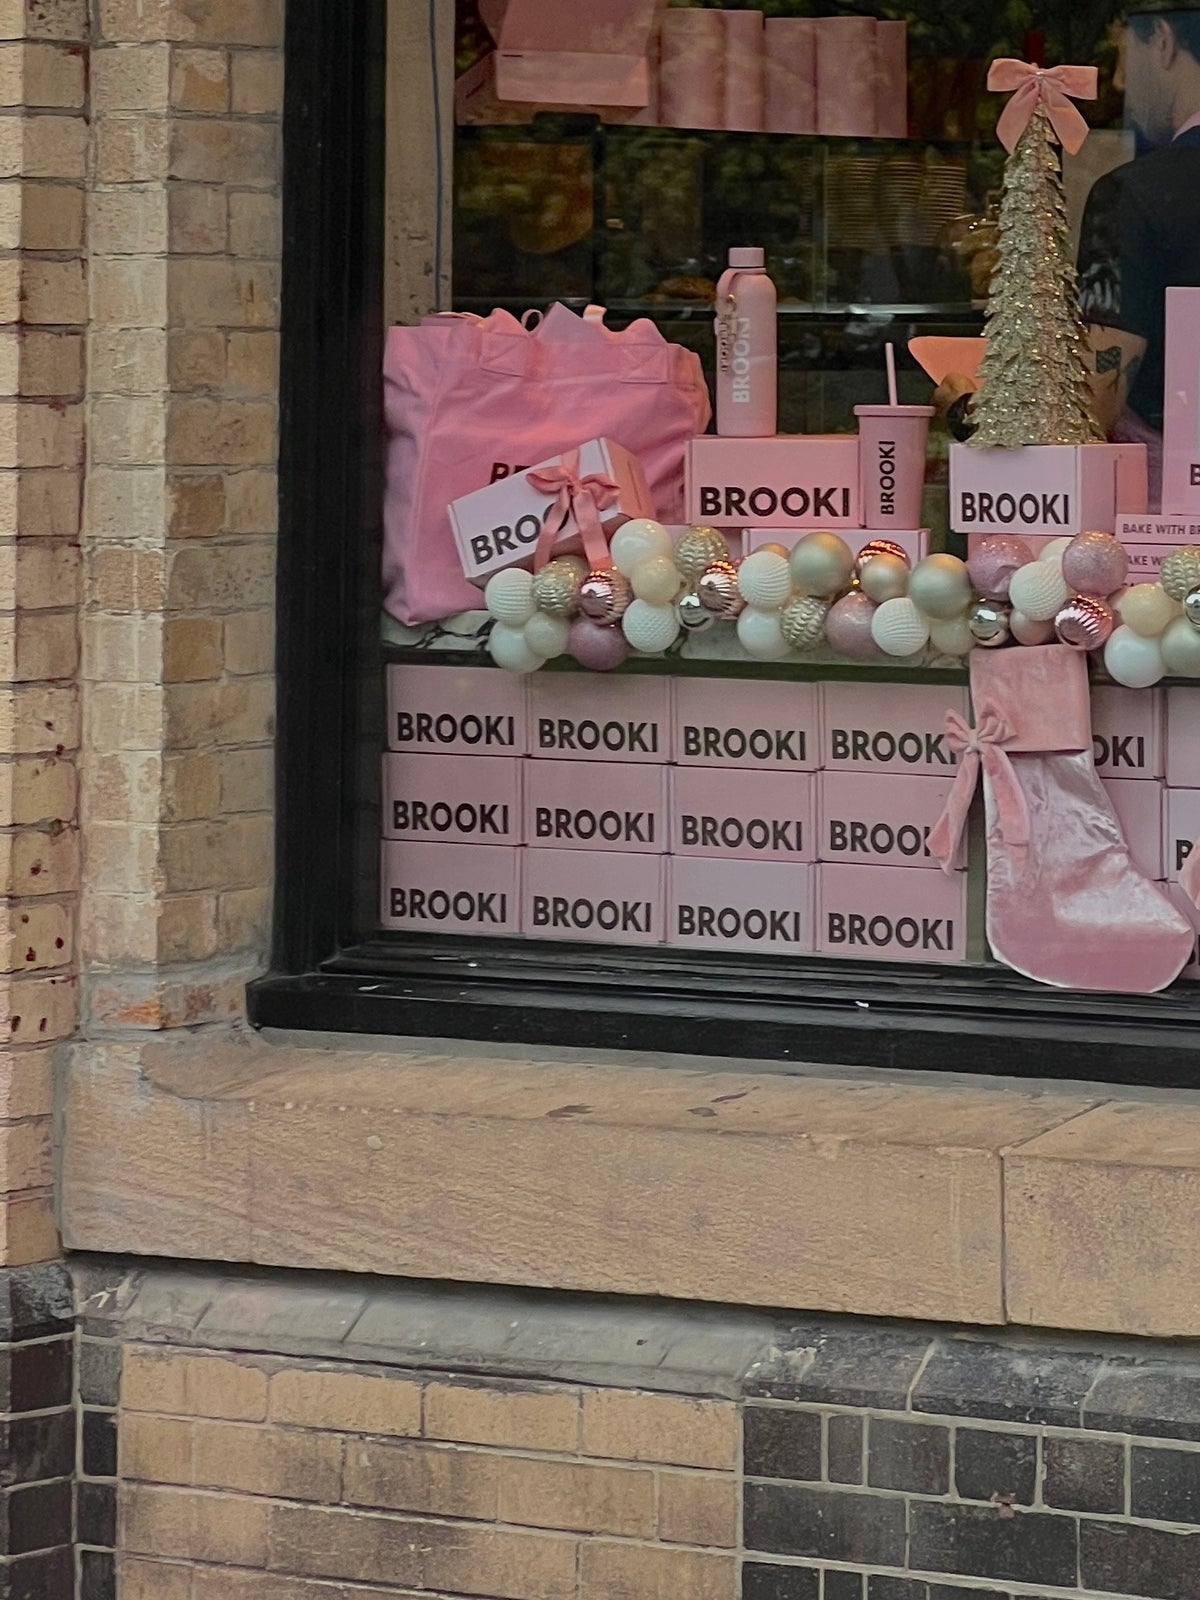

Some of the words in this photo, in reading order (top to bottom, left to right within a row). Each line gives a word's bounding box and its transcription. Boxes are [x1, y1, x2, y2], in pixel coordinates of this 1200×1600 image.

[881, 440, 896, 515] BROOKI
[700, 486, 850, 518] BROOKI
[961, 492, 1069, 525] BROOKI
[471, 502, 569, 565] BROO
[1122, 523, 1152, 534] BAKE
[1154, 524, 1186, 535] WITH
[1127, 555, 1153, 566] AKE
[397, 712, 515, 746] BROOKI
[538, 719, 658, 753] BROOKI
[683, 726, 806, 761] BROOKI
[393, 801, 509, 835] BROOKI
[535, 807, 654, 843] BROOKI
[681, 815, 802, 851] BROOKI
[829, 820, 931, 856] BROO
[390, 888, 506, 924] BROOKI
[532, 897, 651, 933] BROOKI
[678, 905, 800, 942] BROOKI
[828, 913, 954, 951] BROOKI
